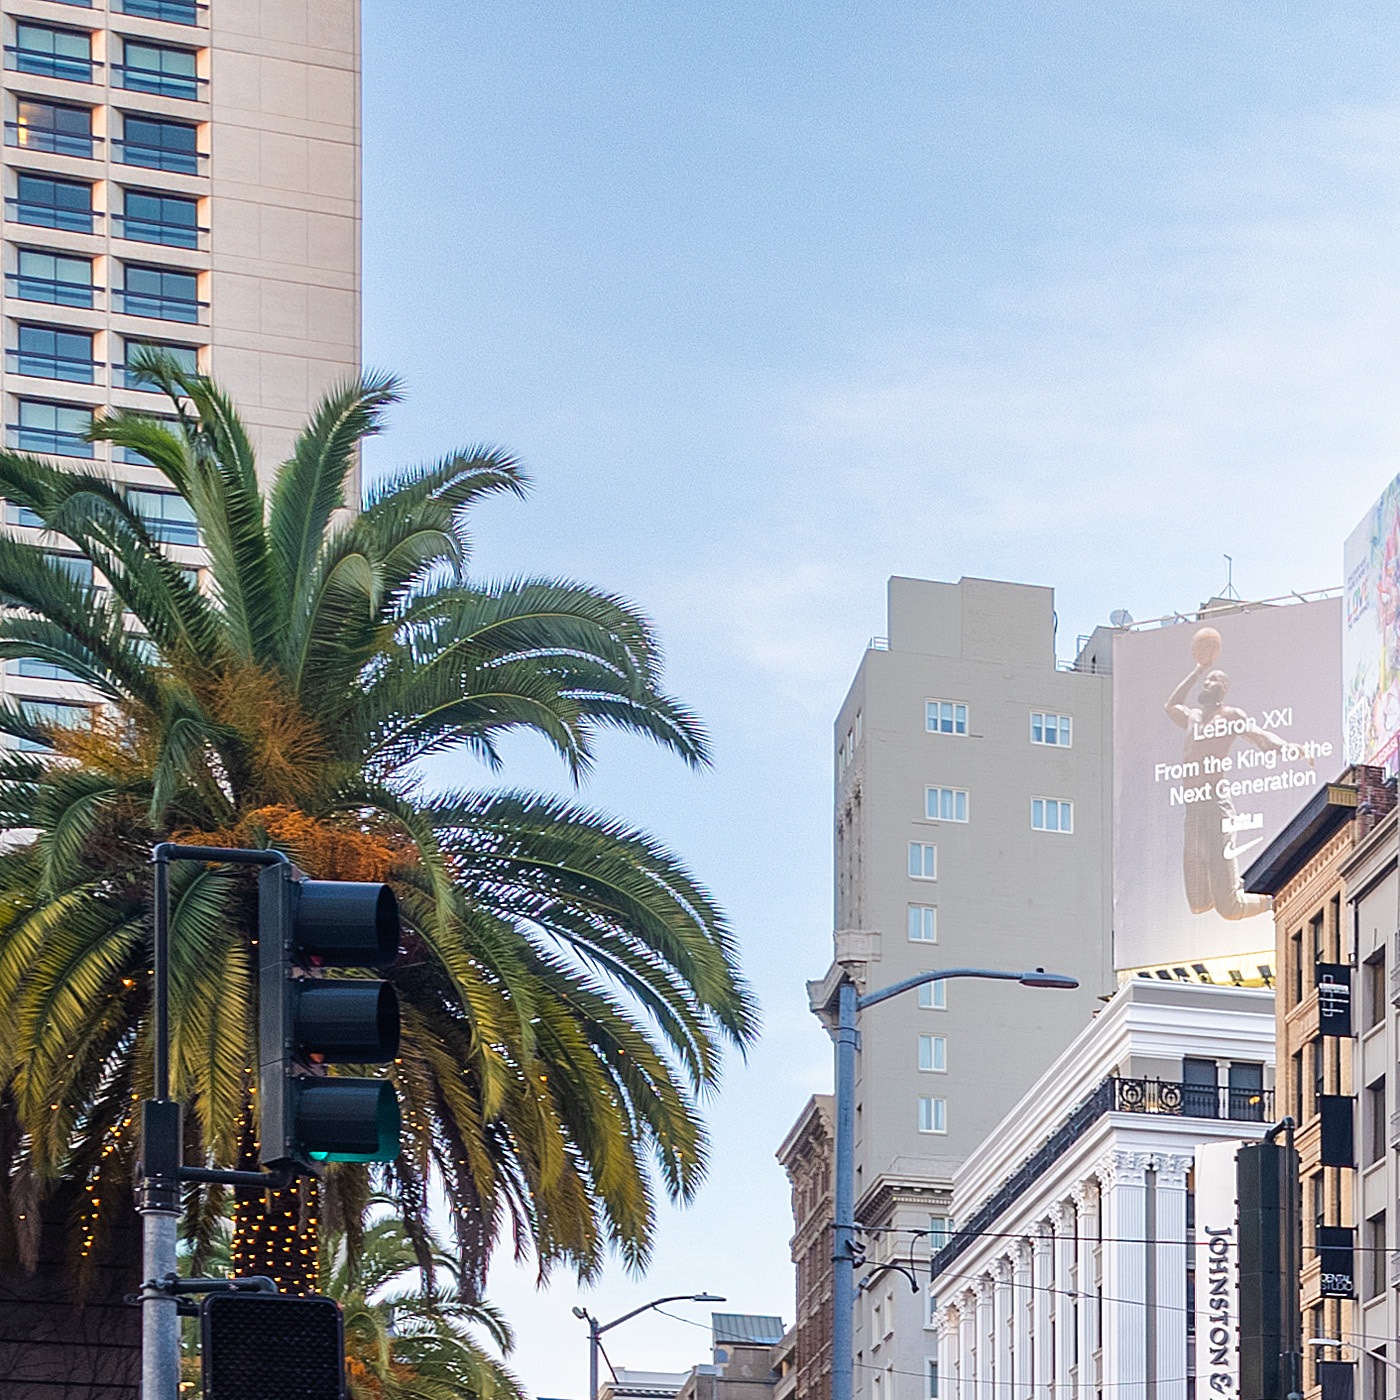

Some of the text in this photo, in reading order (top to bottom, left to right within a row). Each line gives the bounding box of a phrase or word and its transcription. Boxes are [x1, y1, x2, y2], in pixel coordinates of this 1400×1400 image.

[1194, 707, 1293, 741] LeBron XXI
[1154, 740, 1333, 782] From the King to the
[1169, 769, 1317, 806] Next Generation
[1204, 1226, 1232, 1367] JOHNSTON
[1209, 1371, 1232, 1394] &
